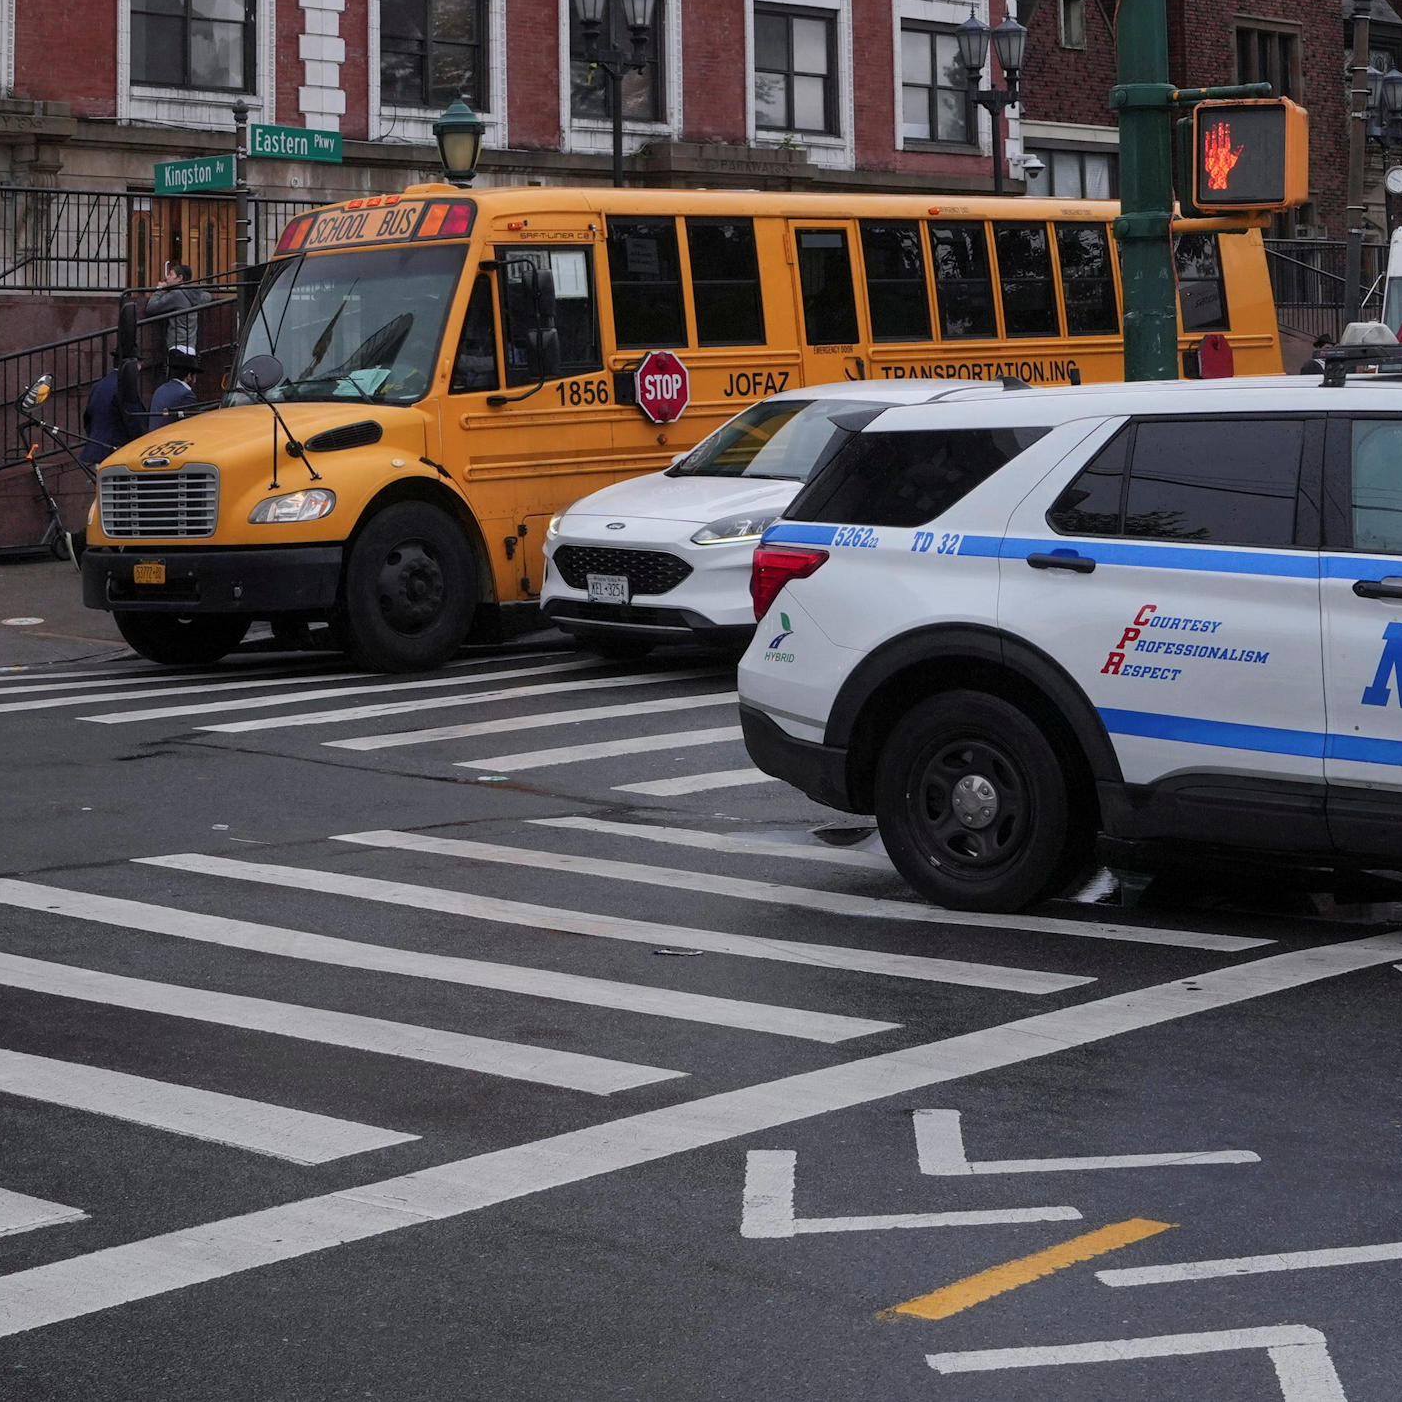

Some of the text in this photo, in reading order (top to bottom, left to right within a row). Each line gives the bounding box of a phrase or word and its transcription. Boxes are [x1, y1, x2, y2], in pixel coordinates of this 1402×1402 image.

[255, 129, 335, 156] Eastern Pkwy
[164, 161, 224, 191] Kingston Av
[308, 207, 417, 246] SCHOOL BUS
[556, 380, 608, 406] 1856
[645, 374, 682, 399] STOP
[724, 372, 790, 397] JOFAZ
[139, 440, 195, 457] 1856
[910, 531, 960, 555] TD 32
[764, 651, 795, 663] HYBRID
